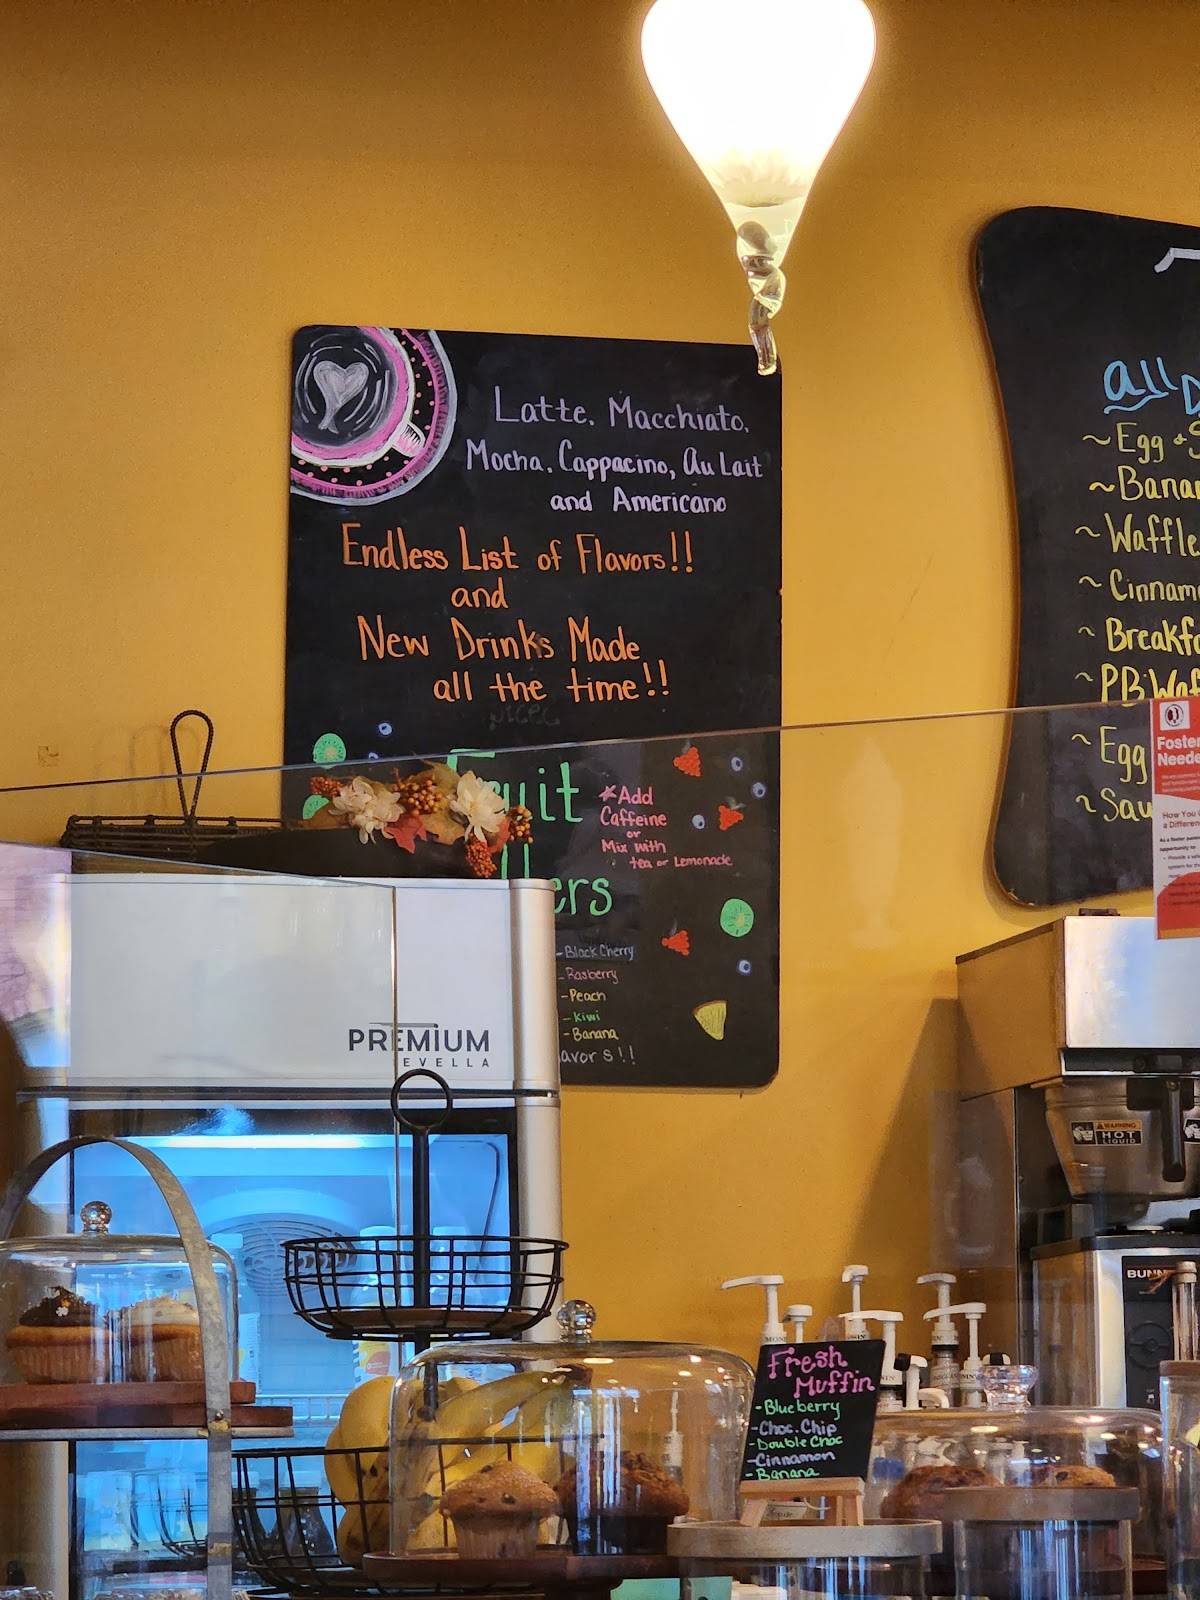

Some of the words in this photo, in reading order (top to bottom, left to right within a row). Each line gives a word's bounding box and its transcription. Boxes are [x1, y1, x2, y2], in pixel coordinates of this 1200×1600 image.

[1116, 422, 1164, 464] Egg
[683, 447, 715, 476] Au
[719, 451, 763, 478] Lait
[550, 490, 593, 512] and
[612, 486, 727, 513] Americano
[341, 522, 449, 570] Endless
[458, 526, 519, 571] List
[537, 539, 562, 572] of
[451, 577, 508, 608] and
[1109, 568, 1200, 602] Cinnam
[356, 614, 429, 660] New
[450, 616, 554, 661] Drinks
[567, 615, 640, 663] Made
[433, 671, 473, 702] all
[489, 672, 548, 702] the
[1100, 726, 1148, 785] Egg
[600, 805, 667, 827] Caffeine
[601, 839, 628, 853] Mix
[634, 840, 666, 853] with
[626, 830, 641, 838] or
[629, 856, 653, 869] tea
[674, 854, 733, 868] Lemonade
[600, 944, 634, 961] Cherry
[348, 1024, 489, 1052] PREMIUM
[1102, 1131, 1135, 1139] HOT
[768, 1345, 848, 1379] Fresh
[793, 1369, 876, 1399] Muffin
[800, 1418, 838, 1436] Chip
